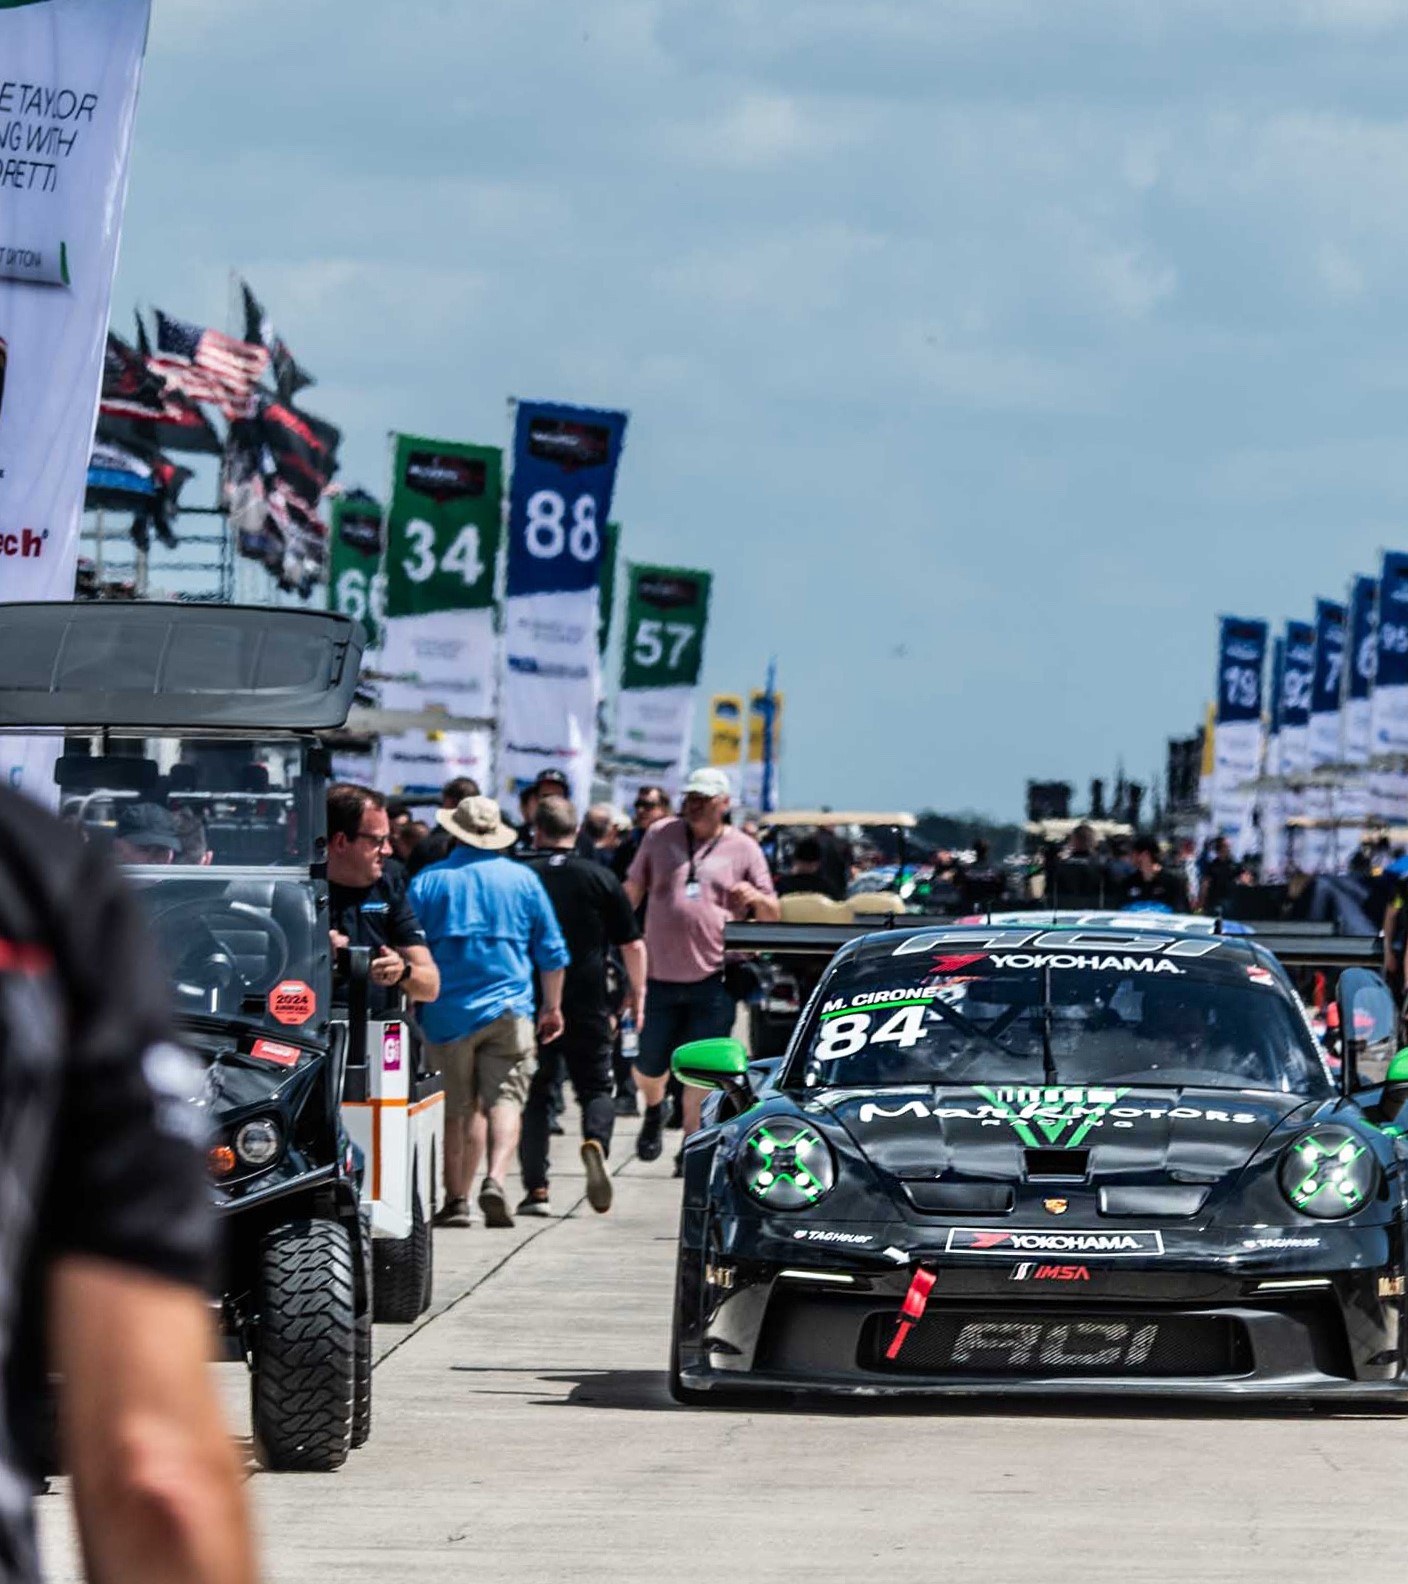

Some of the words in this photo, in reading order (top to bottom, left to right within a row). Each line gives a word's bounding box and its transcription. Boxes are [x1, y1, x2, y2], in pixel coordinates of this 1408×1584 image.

[0, 158, 56, 192] RETTI
[0, 529, 42, 557] ch
[525, 490, 598, 562] 88
[402, 517, 485, 586] 34
[634, 619, 695, 669] 57
[822, 998, 848, 1013] M.
[851, 986, 937, 1006] CIRONE
[814, 1005, 928, 1061] 84
